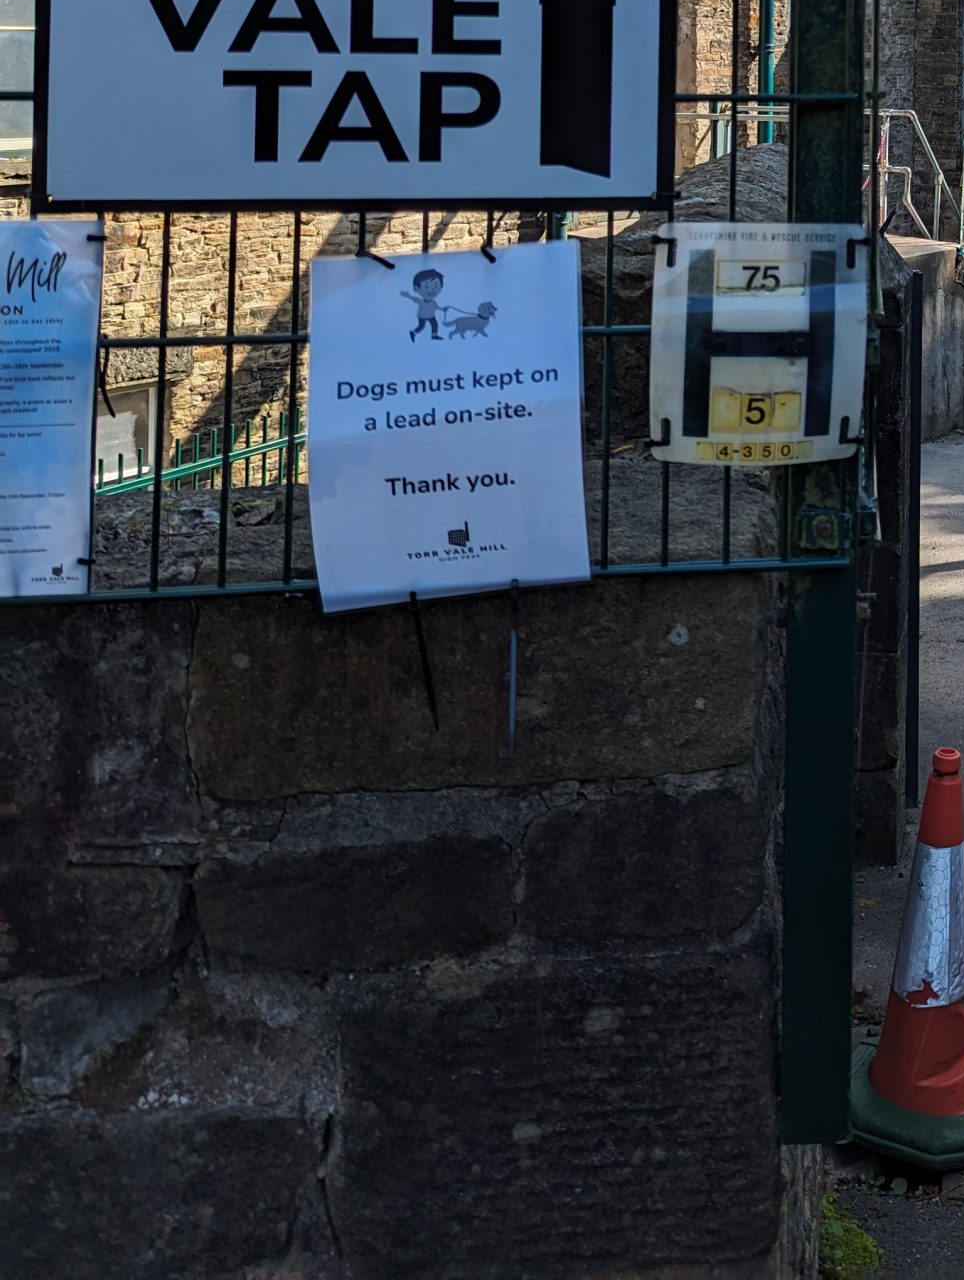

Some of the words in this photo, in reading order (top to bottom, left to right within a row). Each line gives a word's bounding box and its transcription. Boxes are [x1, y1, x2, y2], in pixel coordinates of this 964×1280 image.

[222, 70, 501, 163] TAP
[741, 232, 758, 242] FIRE
[762, 232, 768, 241] &
[771, 232, 801, 242] RESCUE
[804, 232, 836, 243] SERVICE
[7, 251, 67, 303] Mill
[742, 266, 780, 292] 75
[337, 381, 398, 401] Dogs
[405, 373, 465, 395] must
[472, 369, 524, 391] kept
[531, 367, 559, 384] on
[364, 415, 377, 431] a
[386, 408, 436, 429] lead
[444, 402, 533, 425] on-site.
[745, 398, 766, 425] 5
[386, 474, 460, 497] Thank
[466, 472, 516, 493] you.
[407, 550, 439, 560] TORR
[443, 547, 474, 556] VALE
[479, 544, 507, 553] MILL
